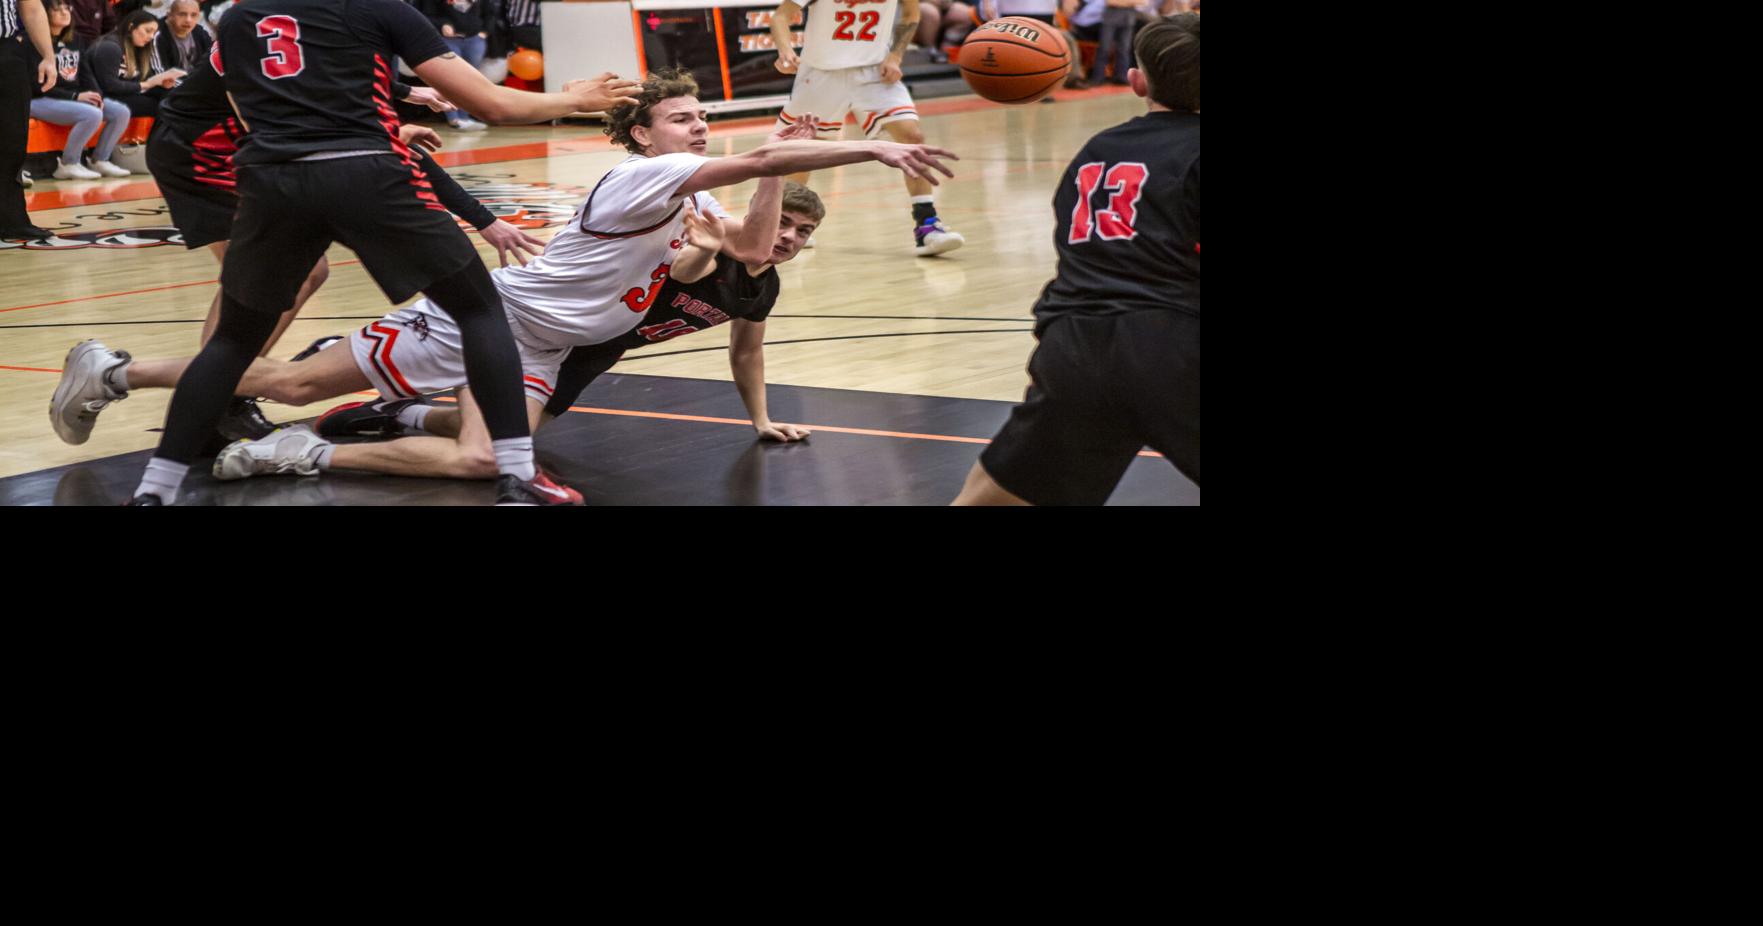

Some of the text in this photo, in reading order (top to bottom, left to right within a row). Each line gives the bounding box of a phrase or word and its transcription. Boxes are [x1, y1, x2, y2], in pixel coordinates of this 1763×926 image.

[256, 15, 305, 80] 3
[832, 10, 880, 41] 22
[973, 22, 1040, 43] Wils
[1068, 161, 1150, 245] 13
